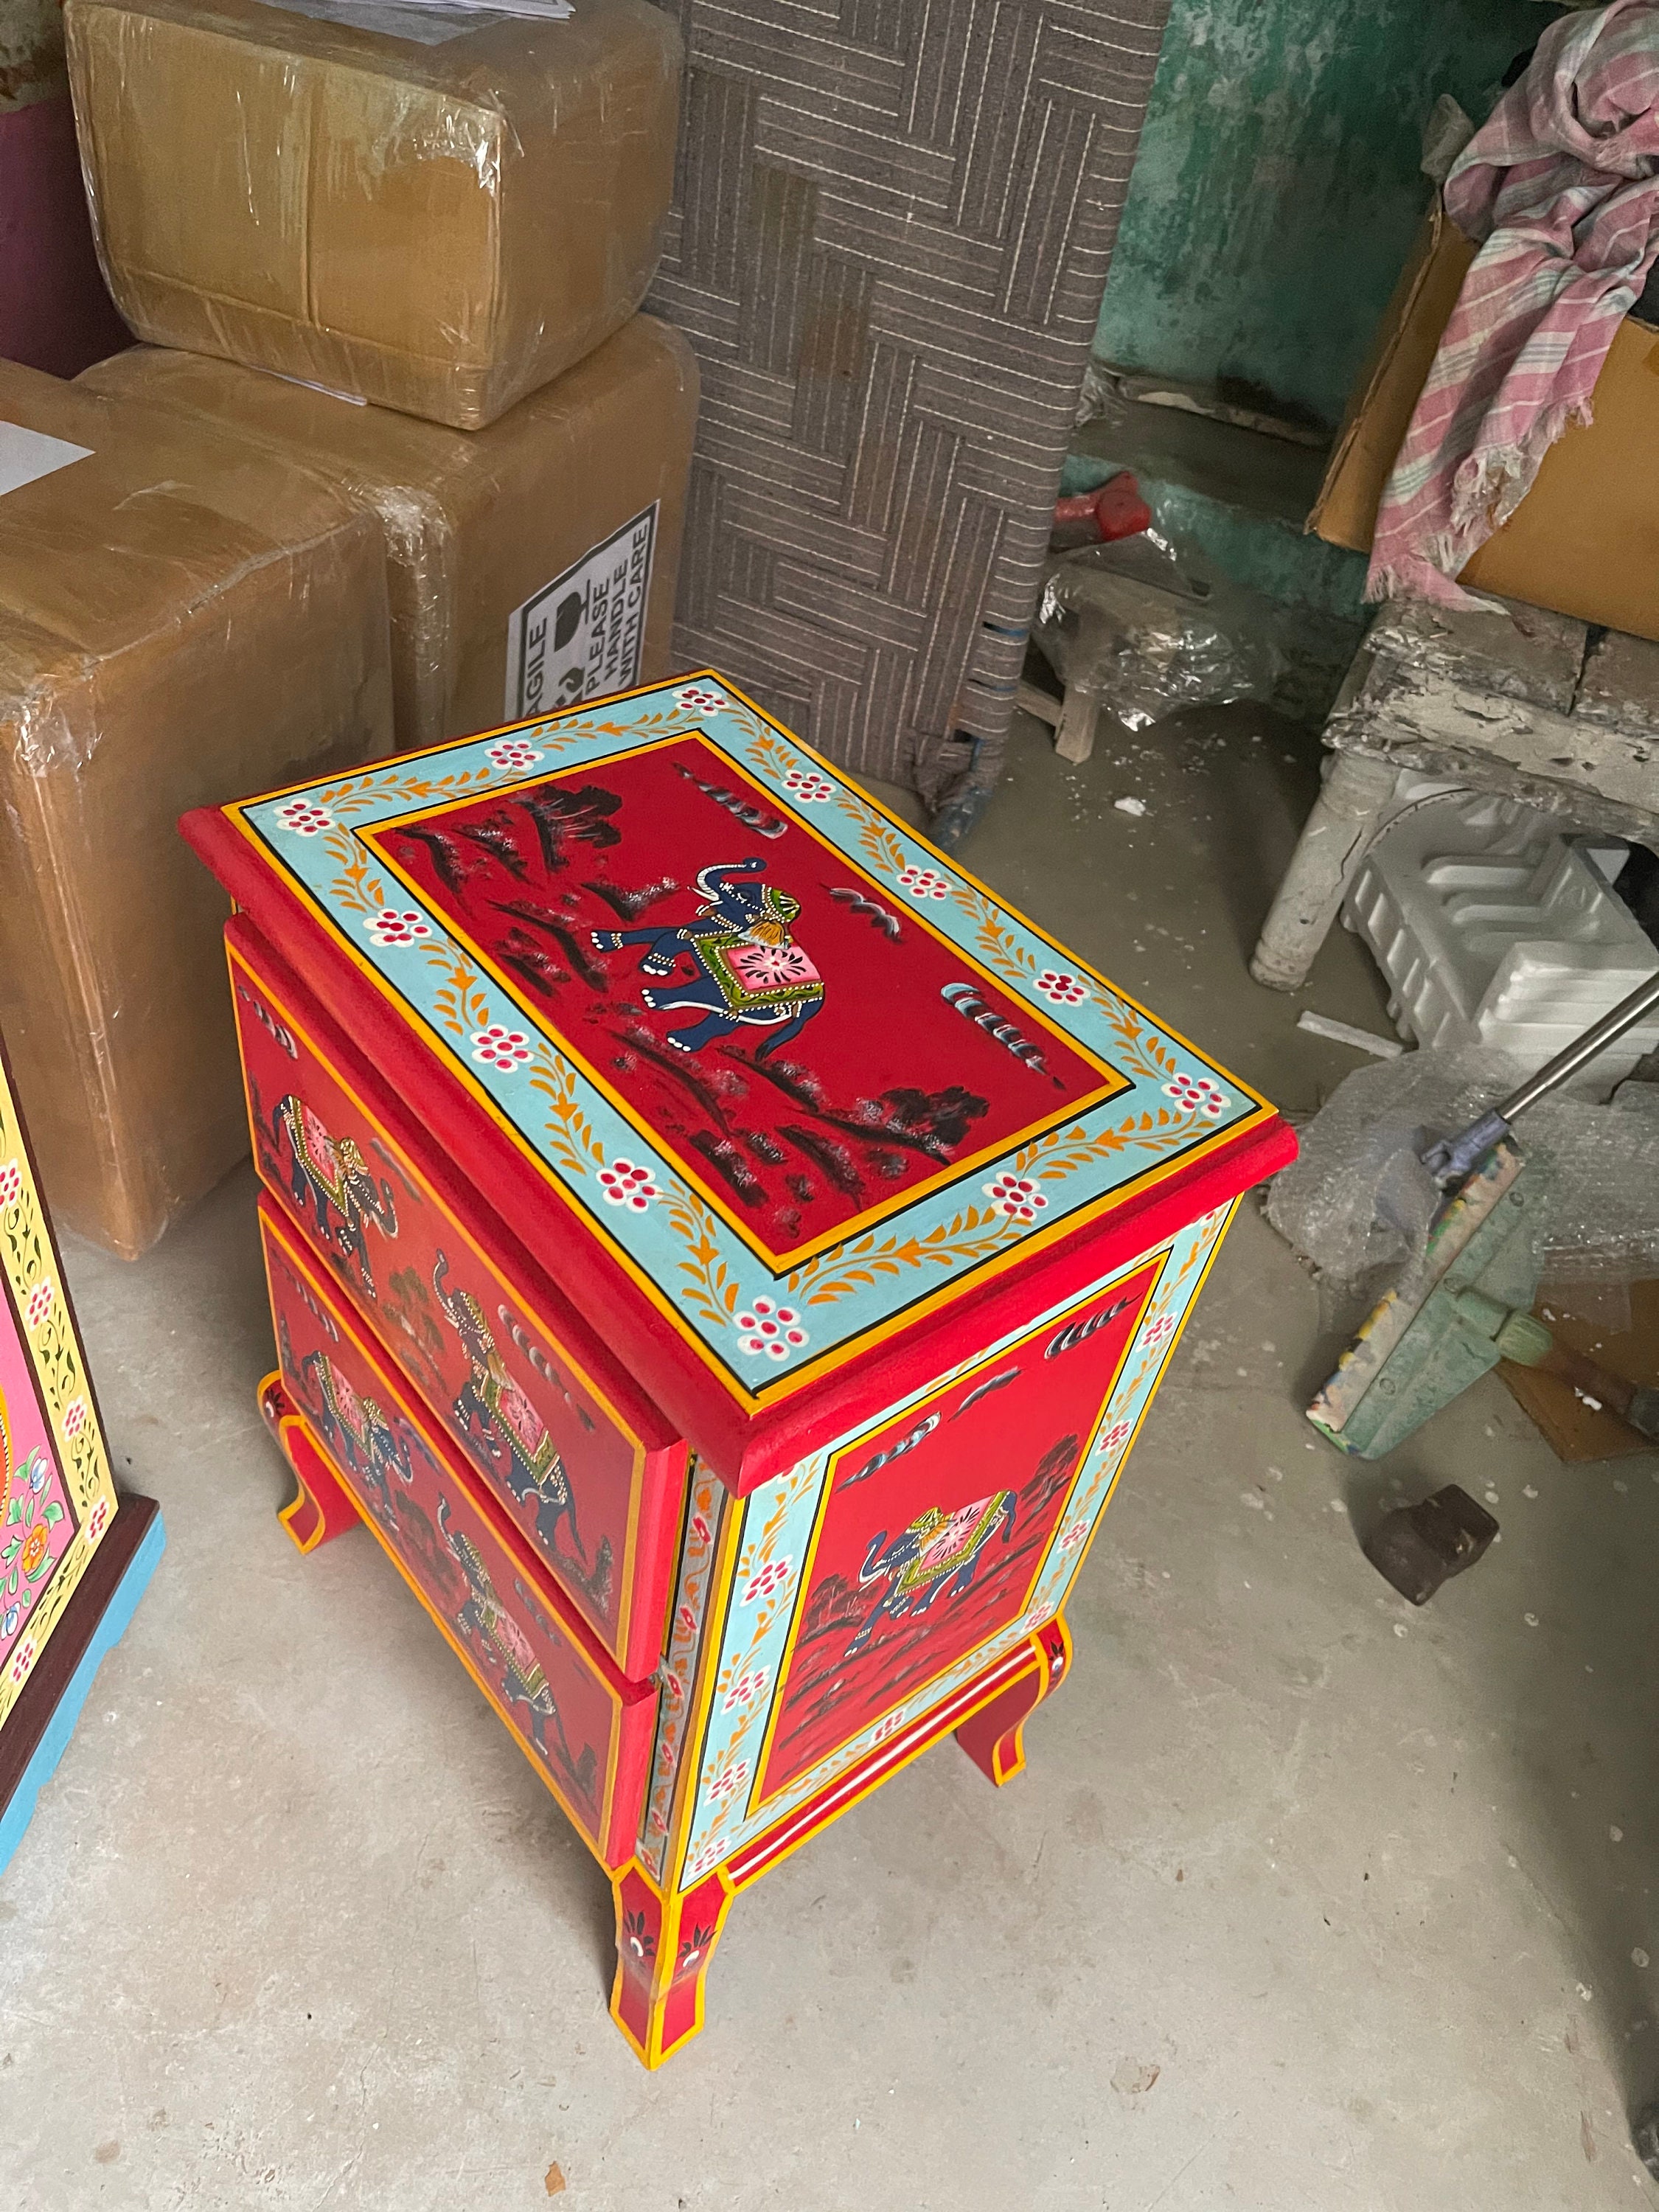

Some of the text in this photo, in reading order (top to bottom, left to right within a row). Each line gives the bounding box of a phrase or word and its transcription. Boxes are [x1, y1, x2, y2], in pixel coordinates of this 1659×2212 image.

[586, 578, 610, 693] PLEASE
[605, 558, 627, 681] HANDLE
[618, 524, 649, 686] WITH CARE
